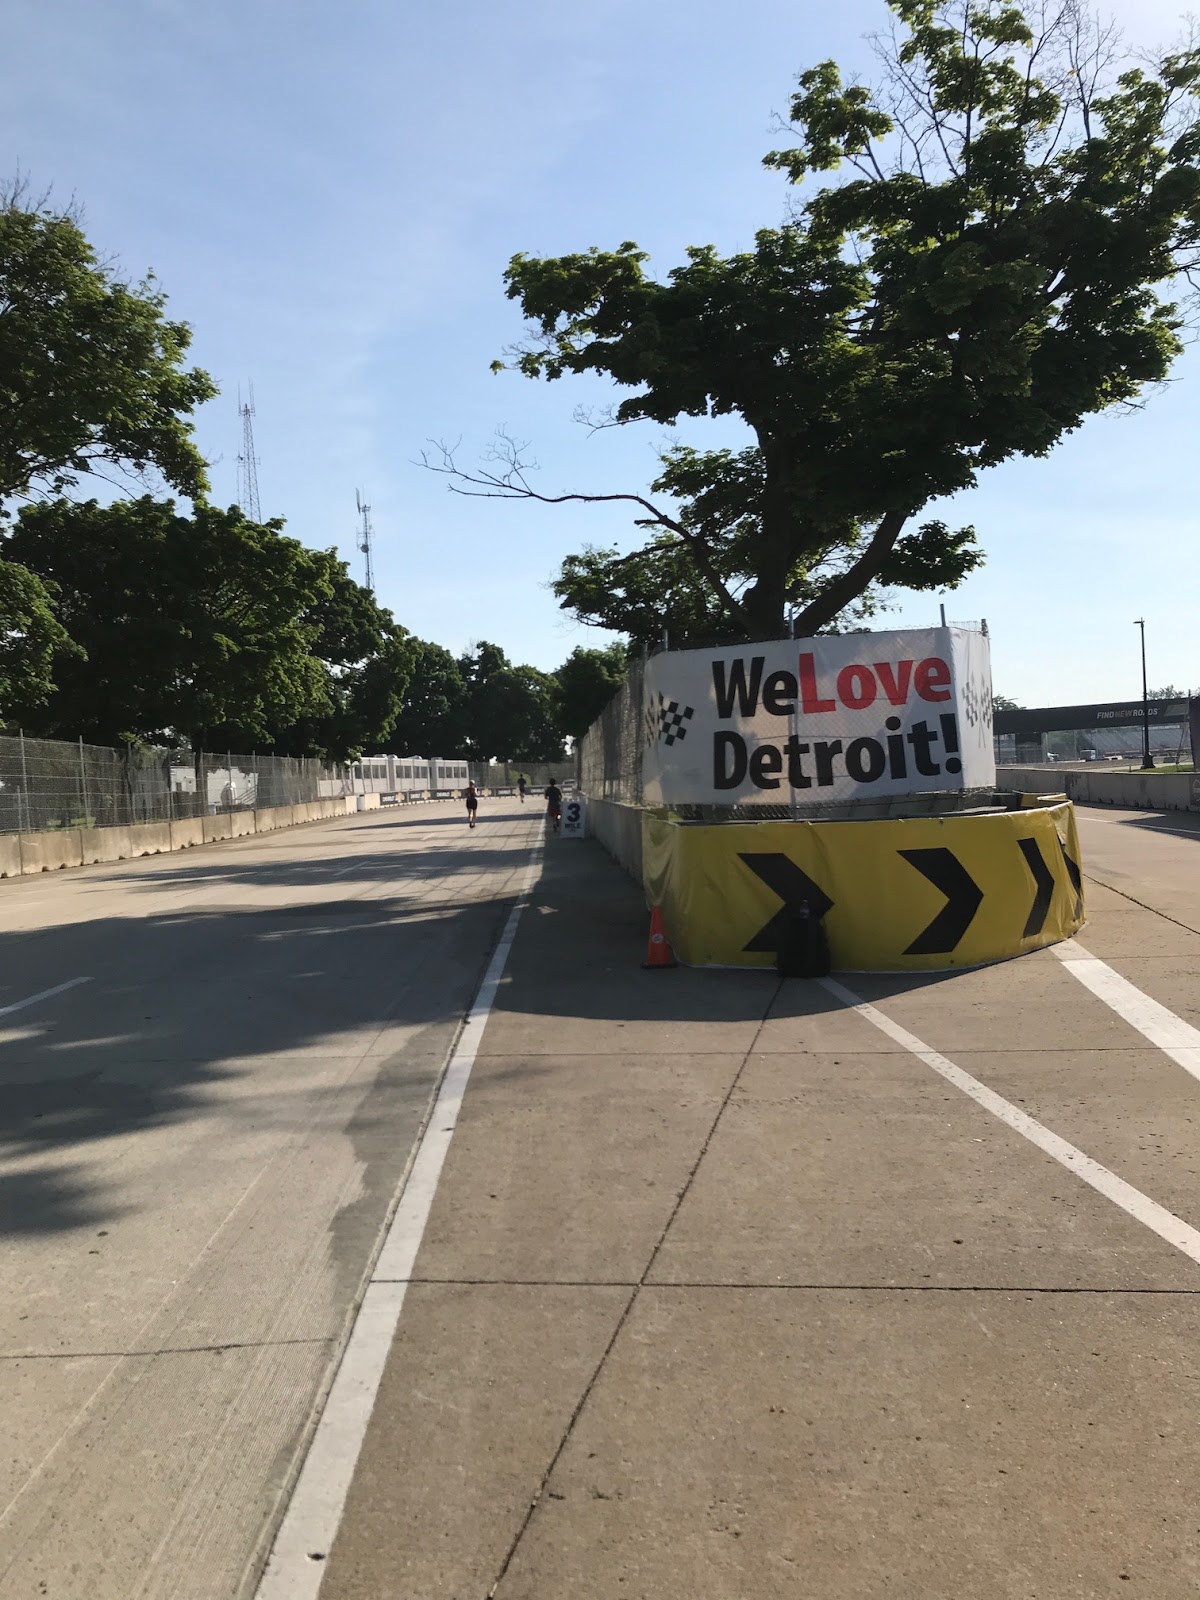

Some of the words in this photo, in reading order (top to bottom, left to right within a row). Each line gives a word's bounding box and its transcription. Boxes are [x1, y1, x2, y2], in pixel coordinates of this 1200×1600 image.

[1096, 711, 1114, 719] FIND
[1132, 707, 1158, 717] RODS
[713, 713, 962, 790] Detroit!
[566, 803, 581, 822] 3
